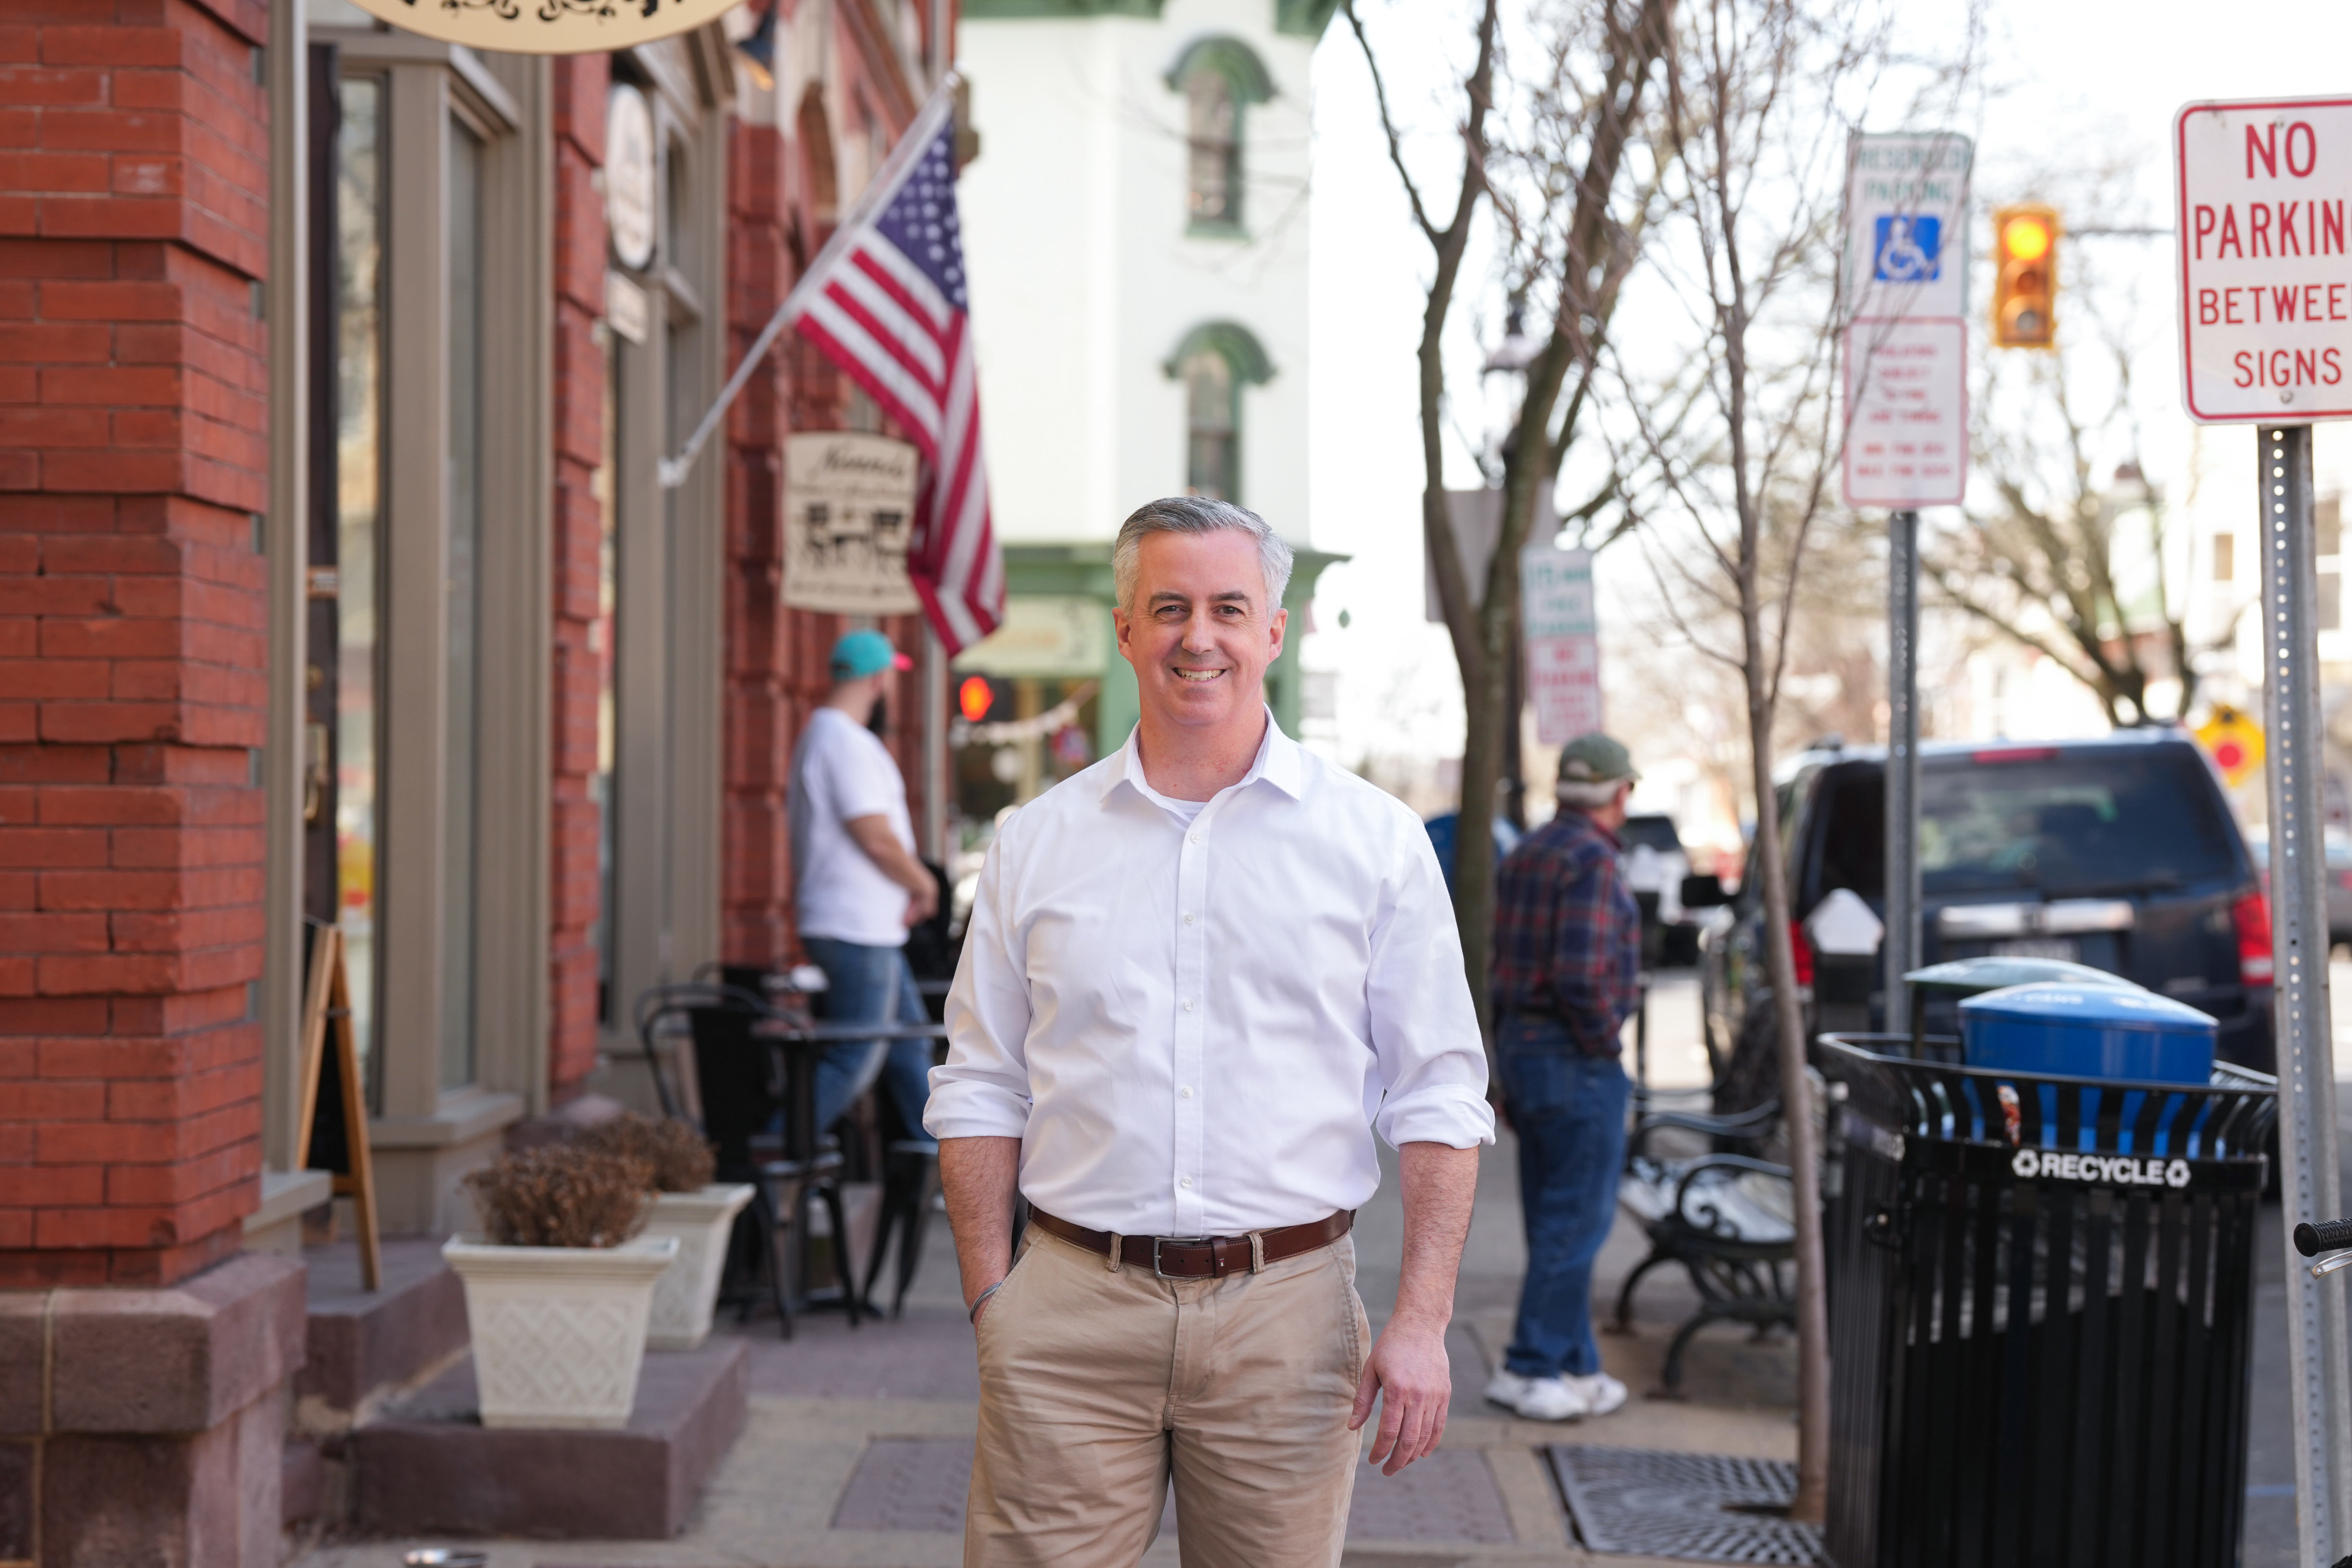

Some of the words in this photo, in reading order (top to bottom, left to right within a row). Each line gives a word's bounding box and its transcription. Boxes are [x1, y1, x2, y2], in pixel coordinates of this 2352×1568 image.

[2246, 121, 2317, 179] NO
[2194, 199, 2352, 260] PARKIN
[2199, 283, 2352, 326] BETWEE
[2233, 347, 2342, 389] SIGNS
[2040, 1152, 2166, 1185] RECYCLE
